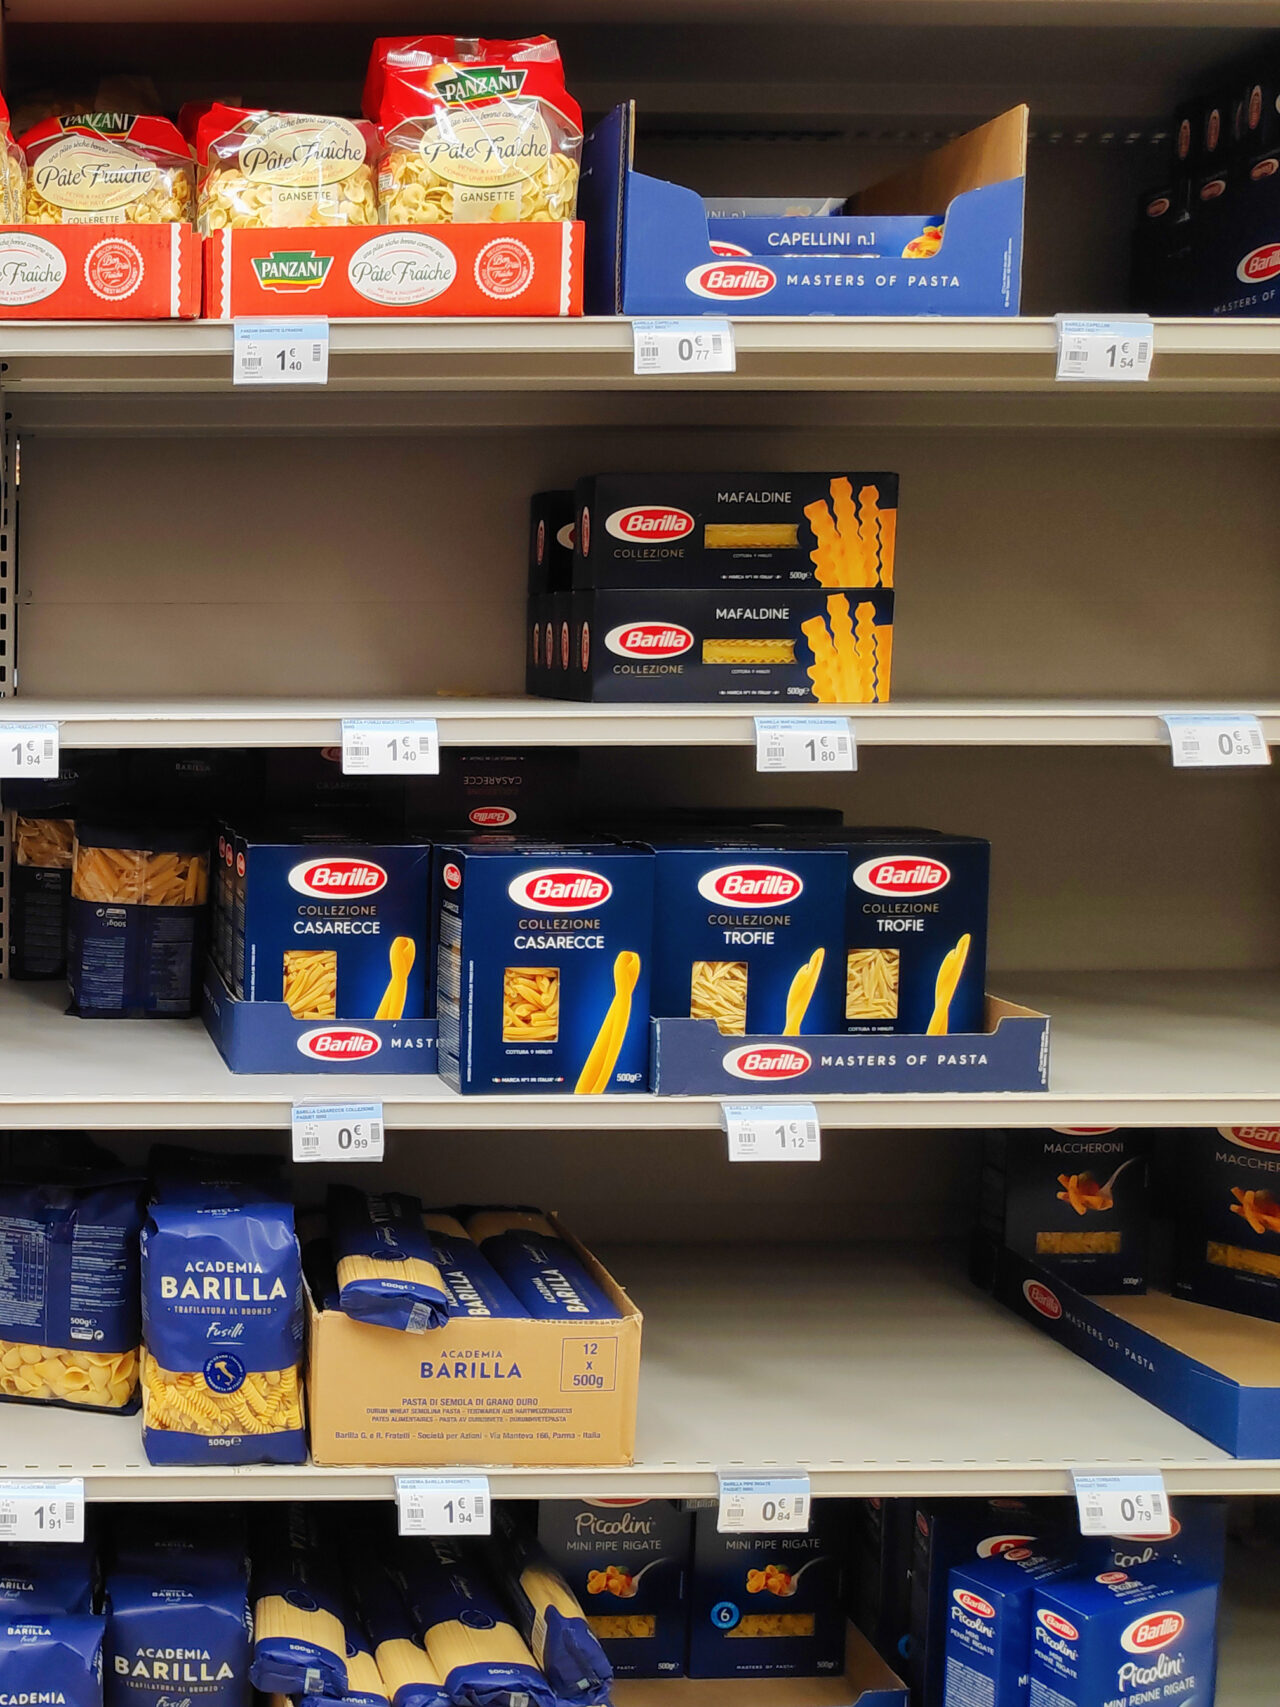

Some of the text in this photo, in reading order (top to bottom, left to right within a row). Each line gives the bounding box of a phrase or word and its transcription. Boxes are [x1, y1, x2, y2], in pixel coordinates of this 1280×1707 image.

[445, 75, 519, 98] PANZANI
[242, 147, 292, 177] Pâte
[424, 143, 475, 164] Pâte
[36, 165, 82, 191] Pâte
[278, 190, 332, 202] GANSETTE
[460, 190, 516, 202] GANSETTE
[767, 232, 876, 247] CAPELLINI n.1
[3, 261, 62, 286] Fraîche
[261, 260, 323, 278] PANZANI
[352, 260, 451, 284] Pâte Fraîche
[706, 271, 769, 289] Barilla
[786, 275, 960, 288] MASTERS OF PASTA
[678, 338, 693, 361] 0
[1106, 345, 1116, 367] 1
[277, 350, 285, 371] 1
[717, 491, 792, 504] MAFALDINE
[626, 514, 687, 533] Barilla
[613, 548, 685, 559] COLLEZIONE
[715, 608, 790, 620] MAFALDINE
[625, 631, 687, 649] Barilla
[613, 664, 684, 676] COLLEZIONE
[387, 739, 397, 761] 1
[805, 739, 815, 761] 1
[1219, 733, 1233, 755] 0
[12, 743, 21, 765] 1
[311, 868, 378, 888] Barilla
[874, 865, 943, 886] Barilla
[532, 879, 604, 898] Barilla
[722, 876, 796, 897] Barilla
[297, 905, 377, 917] COLLEZIONE
[862, 902, 939, 914] COLLEZIONE
[293, 921, 380, 935] CASARECCE
[518, 919, 601, 930] COLLEZIONE
[707, 914, 791, 926] COLLEZIONE
[877, 919, 925, 933] TROFIE
[514, 935, 605, 950] CASARECCE
[723, 931, 775, 946] TROFIE
[315, 1036, 373, 1052] Barilla
[743, 1052, 804, 1072] Barilla
[821, 1053, 988, 1067] MASTERS OF PASTA
[338, 1128, 352, 1149] 0
[775, 1125, 785, 1148] 1
[1044, 1143, 1124, 1154] MACCHERONI
[184, 1262, 263, 1273] ACADEMIA
[160, 1276, 287, 1301] BARILLA
[446, 1270, 491, 1317] BARILLA
[541, 1269, 590, 1314] BARILLA
[174, 1306, 227, 1315] TRAFILATURA
[230, 1306, 239, 1315] AL
[1027, 1287, 1061, 1316] Barilla
[206, 1321, 244, 1339] Fusilli
[583, 1343, 598, 1355] 12
[1065, 1311, 1155, 1372] MASTERS OF PASTA
[440, 1350, 503, 1359] ACADEMIA
[420, 1362, 523, 1379] BARILLA
[573, 1374, 604, 1389] 500g
[402, 1398, 539, 1406] PASTA DI SEMOLA DI GRANO DURO
[335, 1431, 359, 1440] Barilla
[385, 1431, 410, 1440] Fratelli
[417, 1431, 445, 1440] Società
[446, 1433, 459, 1441] per
[489, 1431, 501, 1440] Via
[502, 1431, 534, 1440] Mantova
[552, 1431, 576, 1440] Parma
[582, 1431, 601, 1440] Italia
[34, 1506, 43, 1529] 1
[444, 1500, 453, 1523] 1
[762, 1501, 776, 1521] 0
[1121, 1498, 1135, 1521] 0
[574, 1512, 652, 1537] Piccolini
[567, 1539, 662, 1551] MINI PIPE RIGATE
[726, 1539, 821, 1550] MINI PIPE RIGATE
[962, 1594, 992, 1616] Barilla
[720, 1608, 730, 1622] 6
[951, 1606, 995, 1639] Piccolini
[7, 1627, 51, 1636] BARILLA
[1136, 1617, 1181, 1643] Barilla
[136, 1648, 211, 1661] ACADEMIA
[115, 1655, 235, 1682] BARILLA
[1117, 1652, 1185, 1692] Piccolini
[1129, 1690, 1162, 1705] PENNE
[1163, 1677, 1195, 1696] RIGATE
